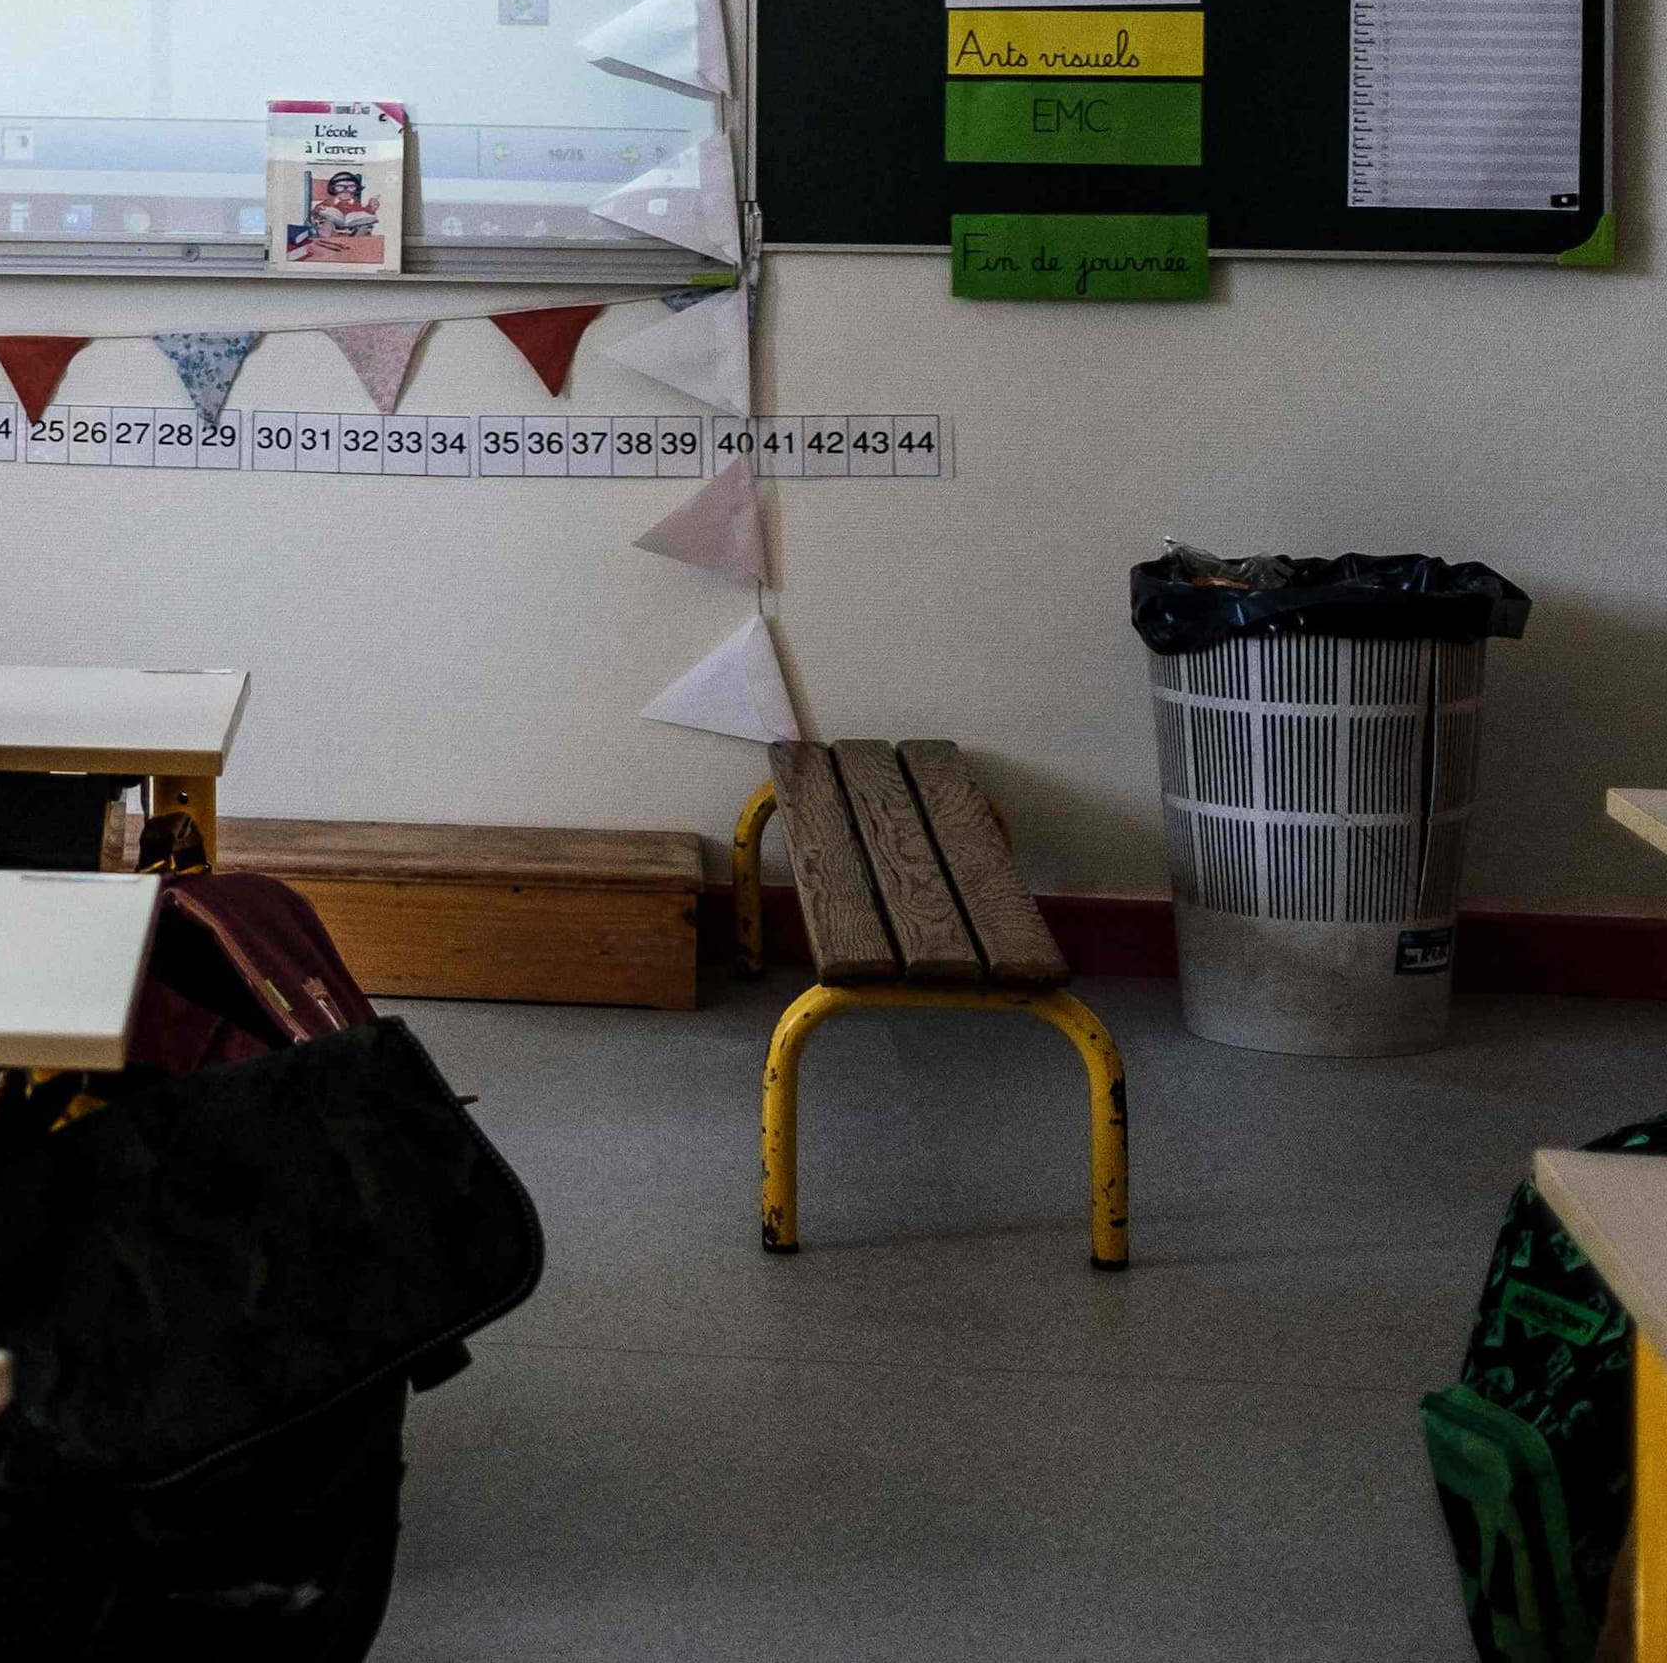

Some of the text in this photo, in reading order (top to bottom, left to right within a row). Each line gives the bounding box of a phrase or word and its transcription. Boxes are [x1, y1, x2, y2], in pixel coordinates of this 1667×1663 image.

[956, 29, 1140, 68] Arts visuels
[314, 123, 359, 139] L'école
[1033, 98, 1111, 133] EMC
[305, 141, 367, 156] à l'envers
[962, 233, 1191, 295] Fin de journée
[30, 419, 65, 442] 25
[72, 420, 108, 444] 26
[115, 422, 151, 445] 27
[158, 423, 193, 447] 28
[200, 424, 237, 449] 29
[257, 426, 292, 450] 30
[300, 427, 330, 451] 31
[343, 429, 380, 453] 32
[387, 430, 423, 454] 33
[431, 431, 467, 455] 34
[483, 431, 520, 455] 35
[527, 431, 564, 455] 36
[572, 431, 608, 455] 37
[616, 431, 653, 455] 38
[661, 431, 697, 455] 39
[717, 431, 754, 457] 40
[762, 431, 794, 454] 41
[807, 431, 844, 454] 42
[852, 431, 890, 455] 43
[897, 431, 935, 454] 44
